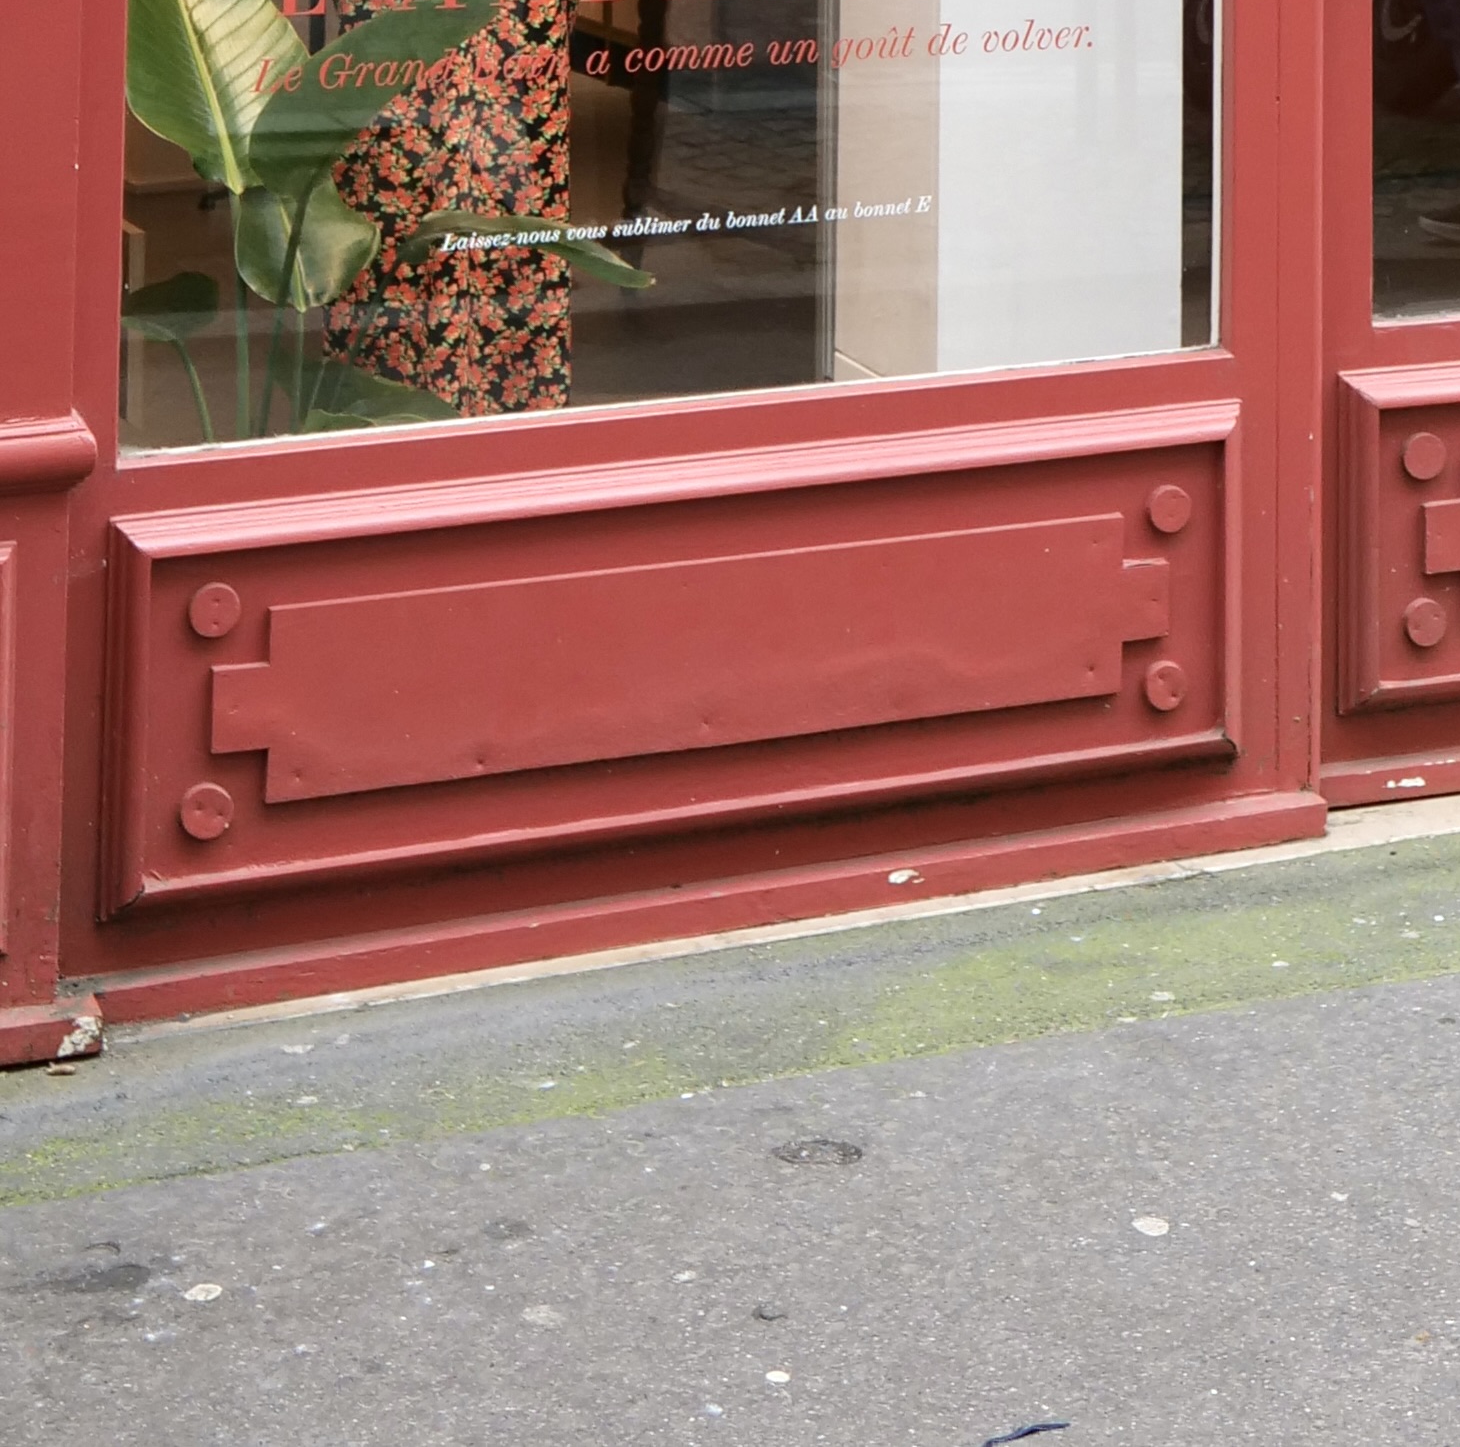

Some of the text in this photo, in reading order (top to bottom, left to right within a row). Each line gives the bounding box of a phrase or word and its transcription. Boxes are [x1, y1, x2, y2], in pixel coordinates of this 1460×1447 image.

[249, 57, 301, 95] Le
[318, 48, 459, 91] Grand
[584, 49, 611, 75] a
[623, 41, 755, 74] comme
[766, 38, 820, 66] un
[832, 25, 916, 68] goût
[927, 23, 970, 56] de
[981, 18, 1094, 51] volver.
[440, 195, 932, 253] Laissez-nous vous sublimer du bonnet AA au bonnet E
